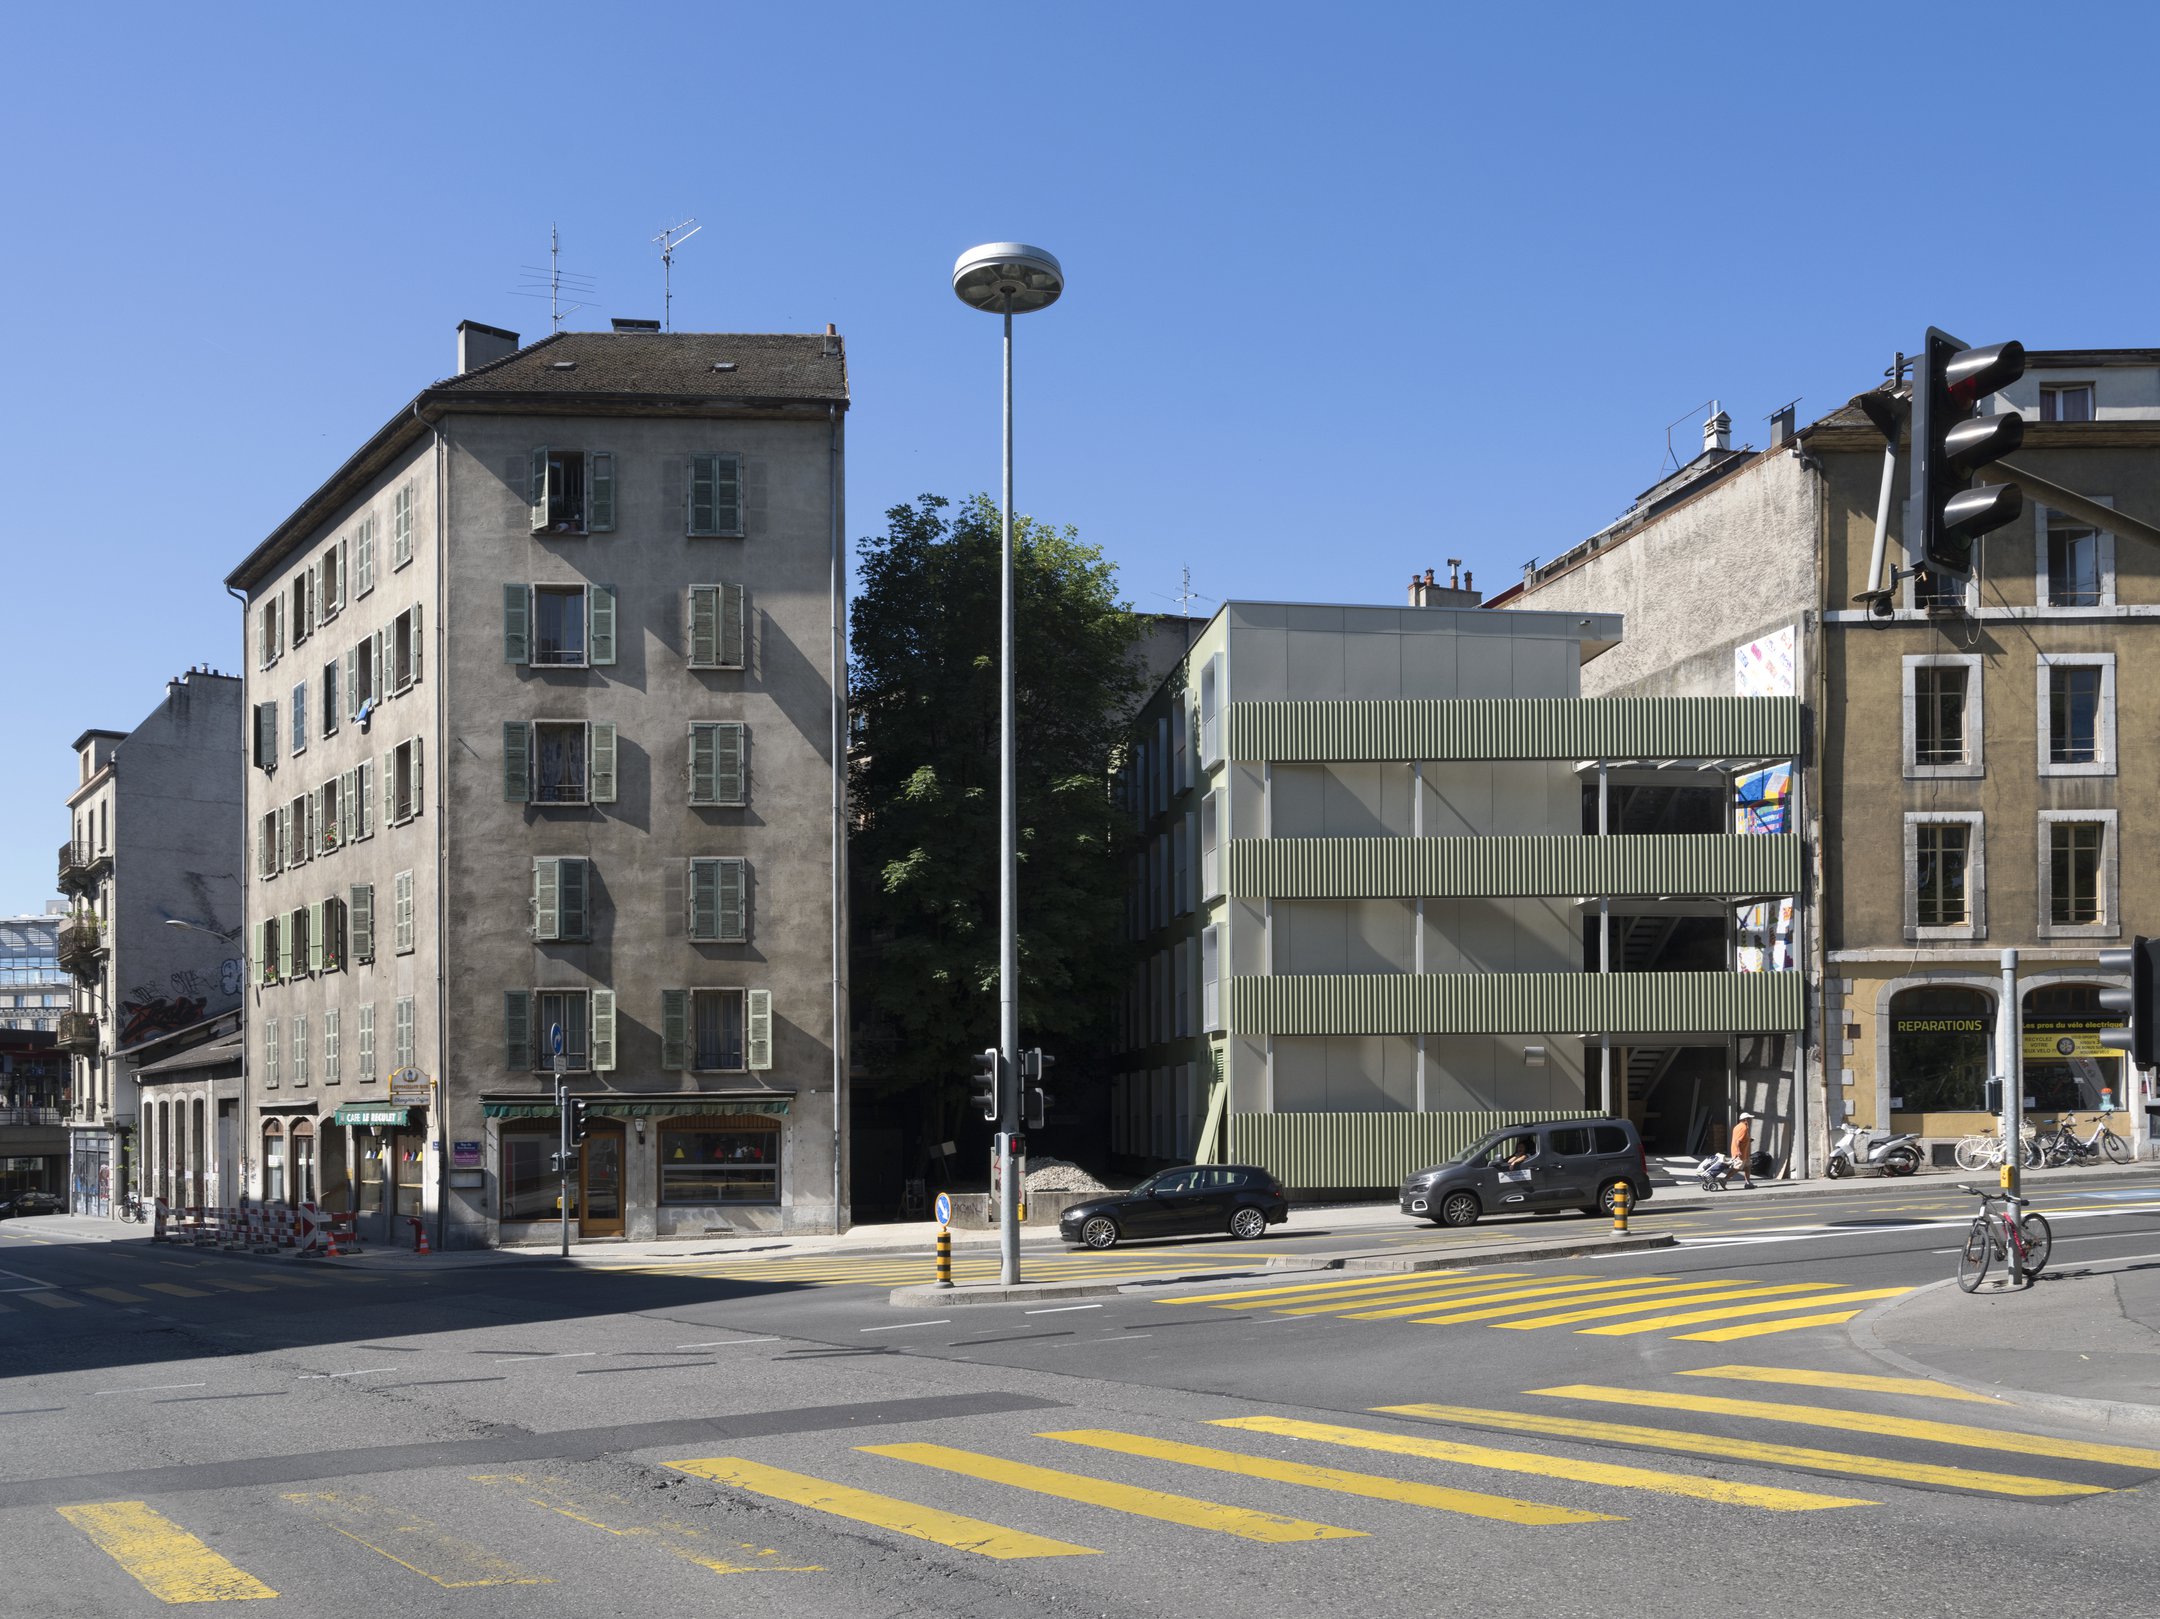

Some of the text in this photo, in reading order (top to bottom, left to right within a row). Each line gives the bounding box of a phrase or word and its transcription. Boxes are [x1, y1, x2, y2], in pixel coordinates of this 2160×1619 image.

[1897, 1020, 1983, 1031] REPARATIONS
[2037, 1022, 2054, 1030] pros
[2055, 1021, 2065, 1029] du
[2067, 1021, 2083, 1029] vélo
[362, 1112, 370, 1122] LE
